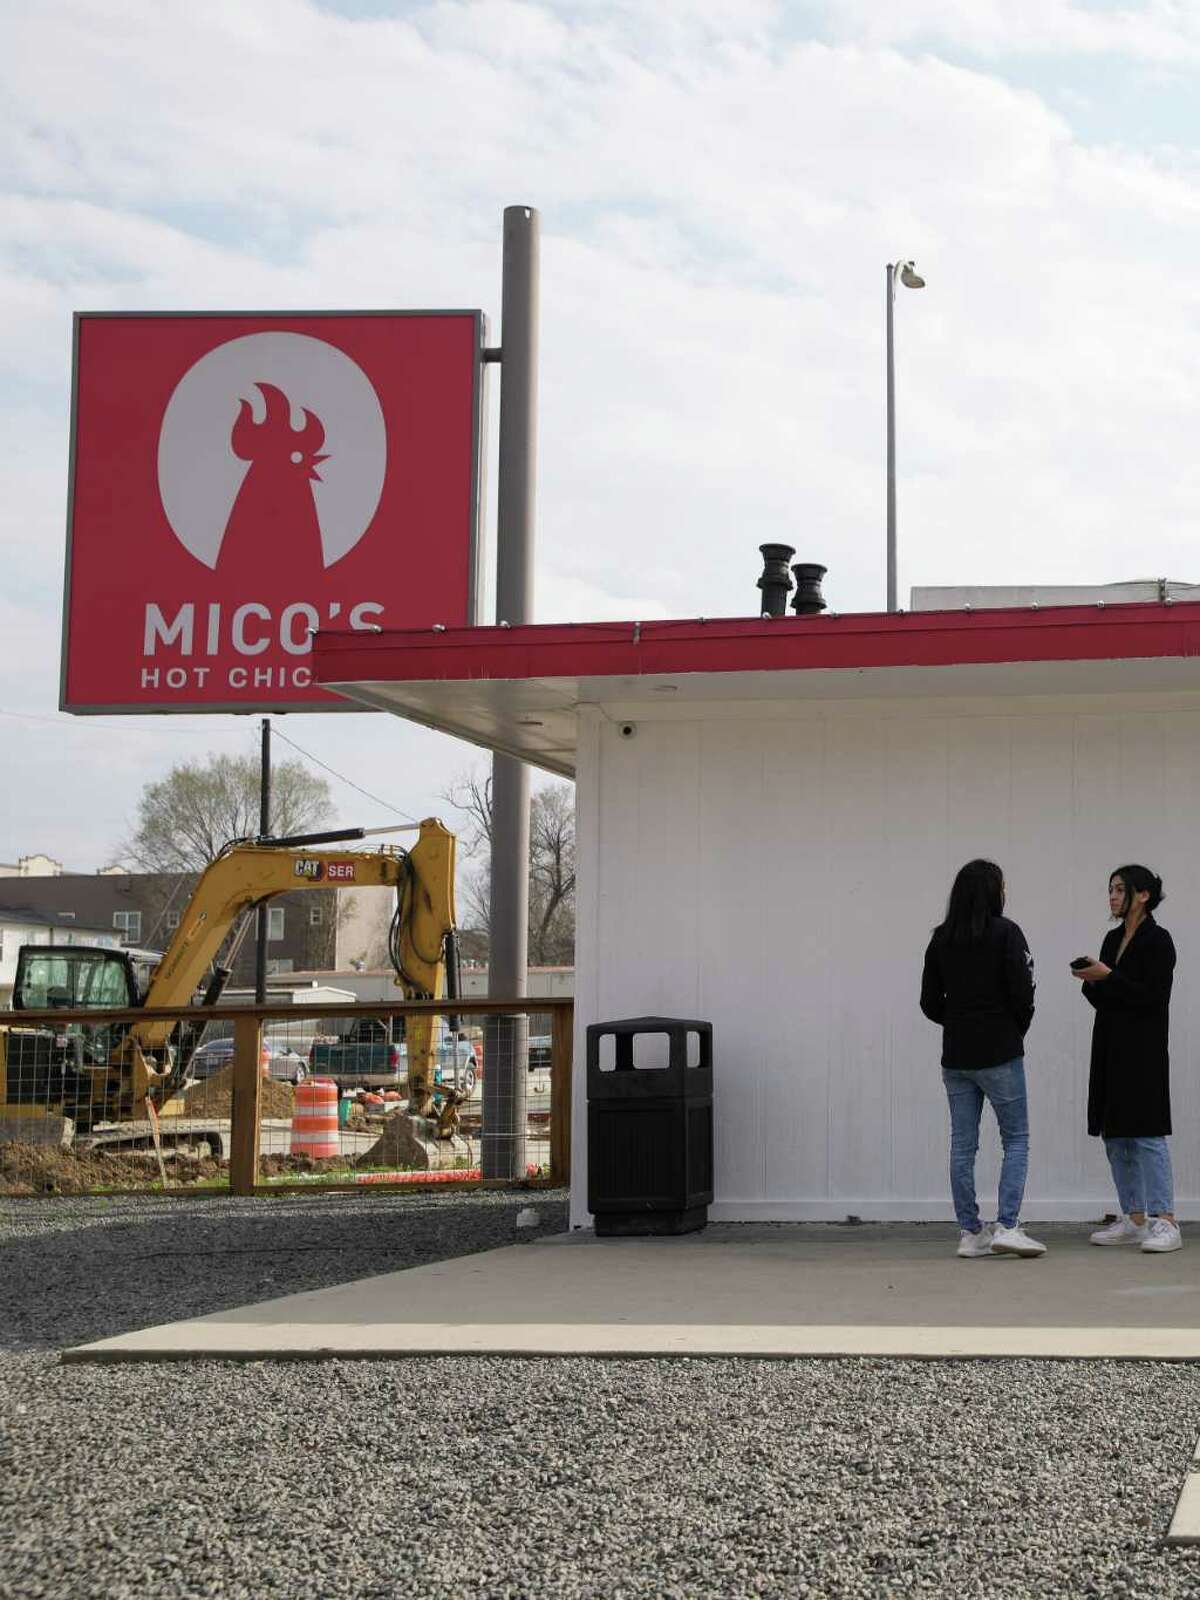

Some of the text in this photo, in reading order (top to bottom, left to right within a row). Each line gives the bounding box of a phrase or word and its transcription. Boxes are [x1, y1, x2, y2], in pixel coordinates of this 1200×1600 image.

[140, 667, 211, 689] HOT
[295, 859, 355, 878] CAT SER
